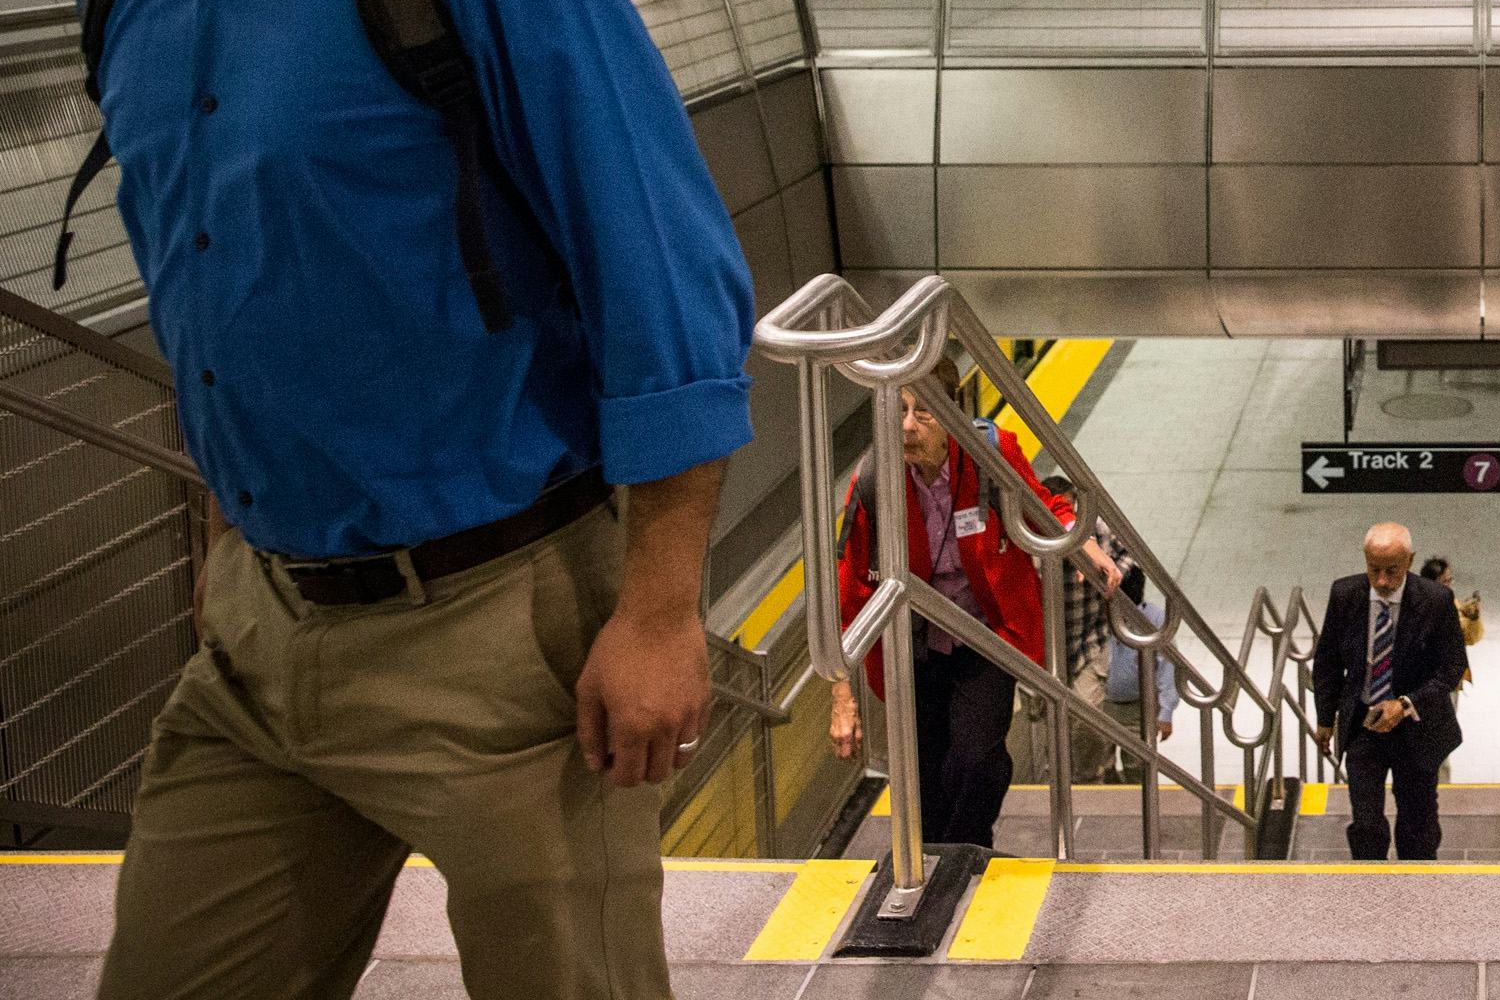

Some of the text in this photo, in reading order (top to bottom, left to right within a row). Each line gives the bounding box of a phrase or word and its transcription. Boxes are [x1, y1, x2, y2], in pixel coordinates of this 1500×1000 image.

[1348, 450, 1433, 469] Track 2
[1474, 461, 1491, 483] 7
